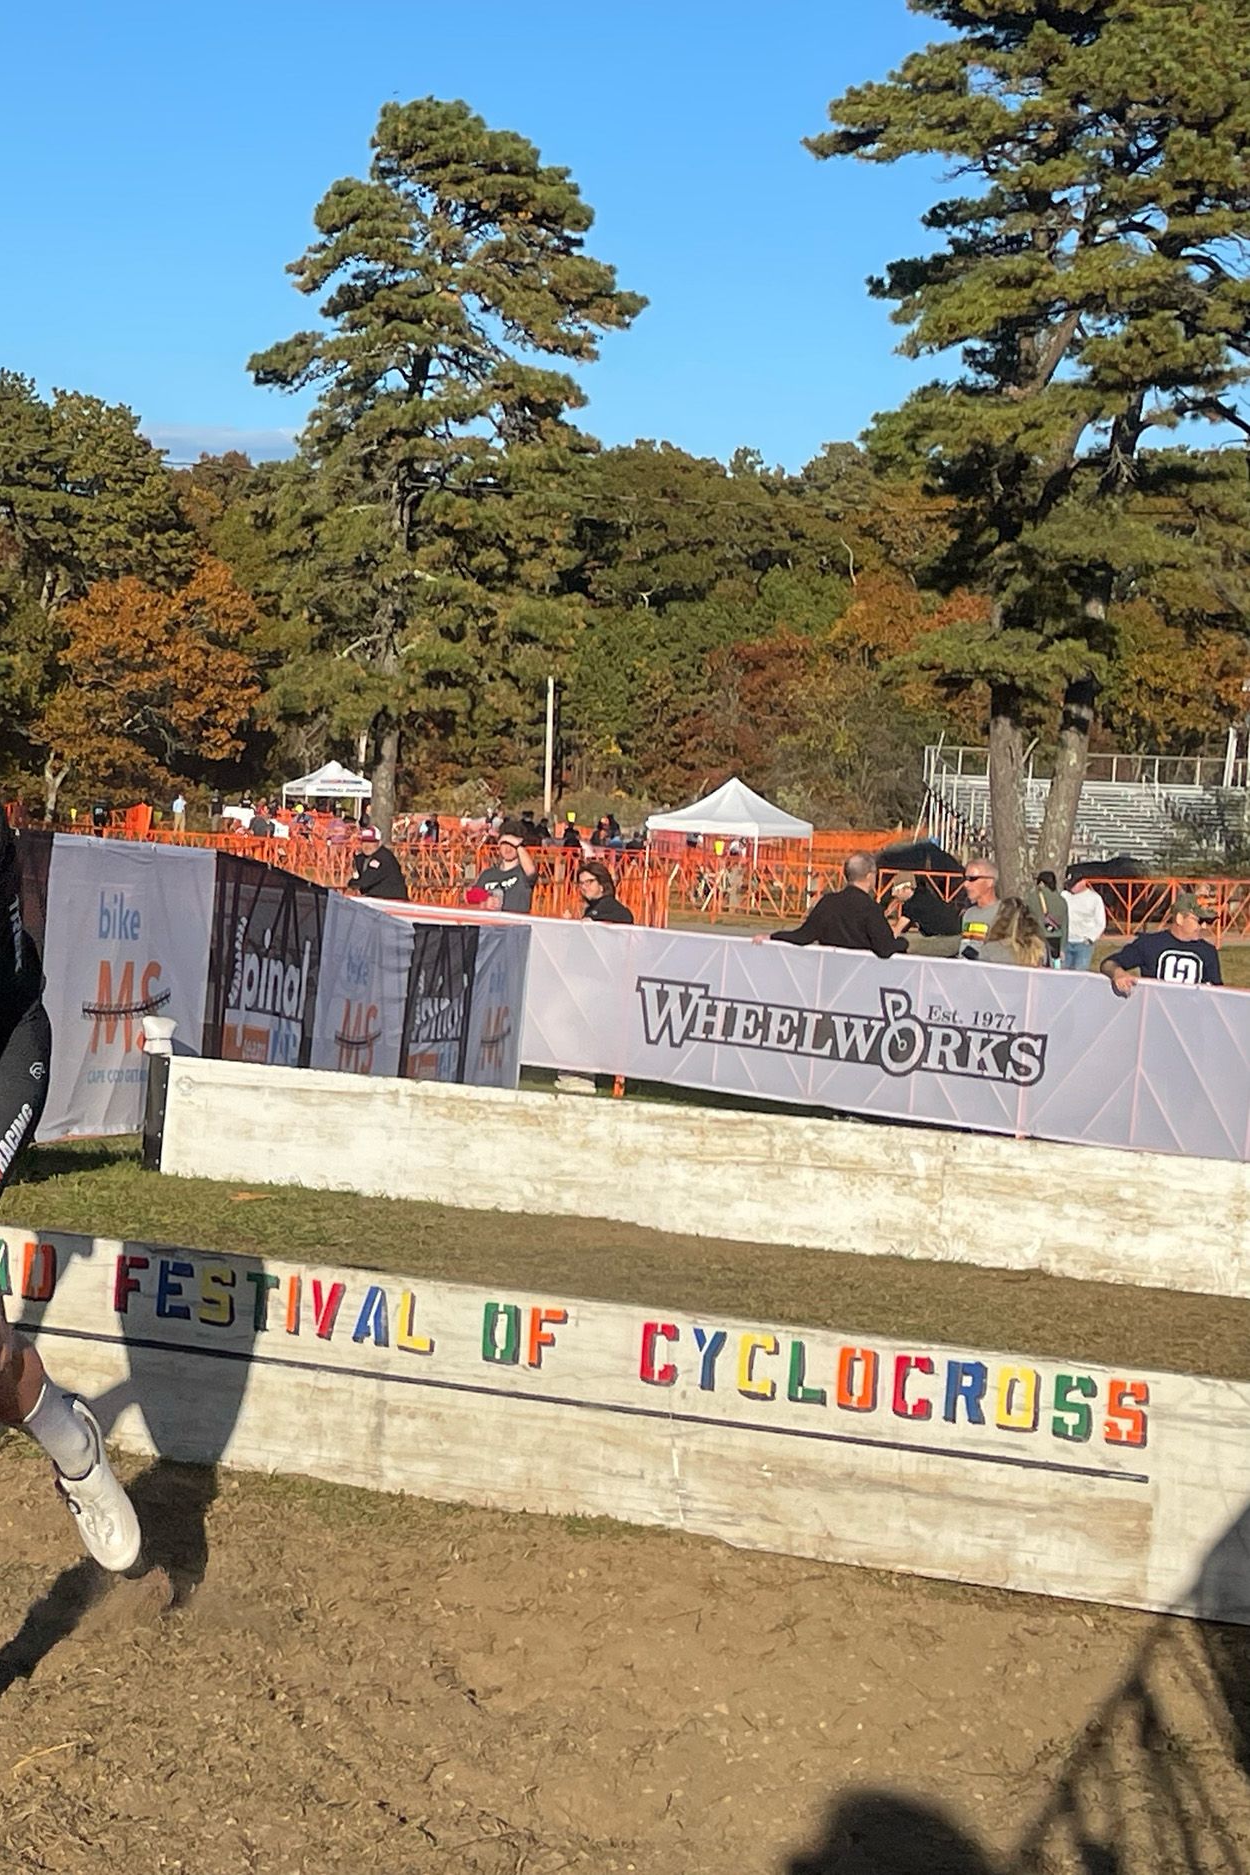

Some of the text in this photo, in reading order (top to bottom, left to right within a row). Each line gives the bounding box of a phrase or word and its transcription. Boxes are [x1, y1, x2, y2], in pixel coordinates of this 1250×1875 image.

[98, 890, 141, 941] bike
[90, 959, 163, 1055] MS
[636, 975, 1048, 1087] WHEELWORKS
[927, 1004, 1016, 1030] Est. 1977
[114, 1254, 435, 1356] FESTIVAL
[482, 1301, 568, 1368] OF
[640, 1321, 1150, 1448] CYCLOCROSS
